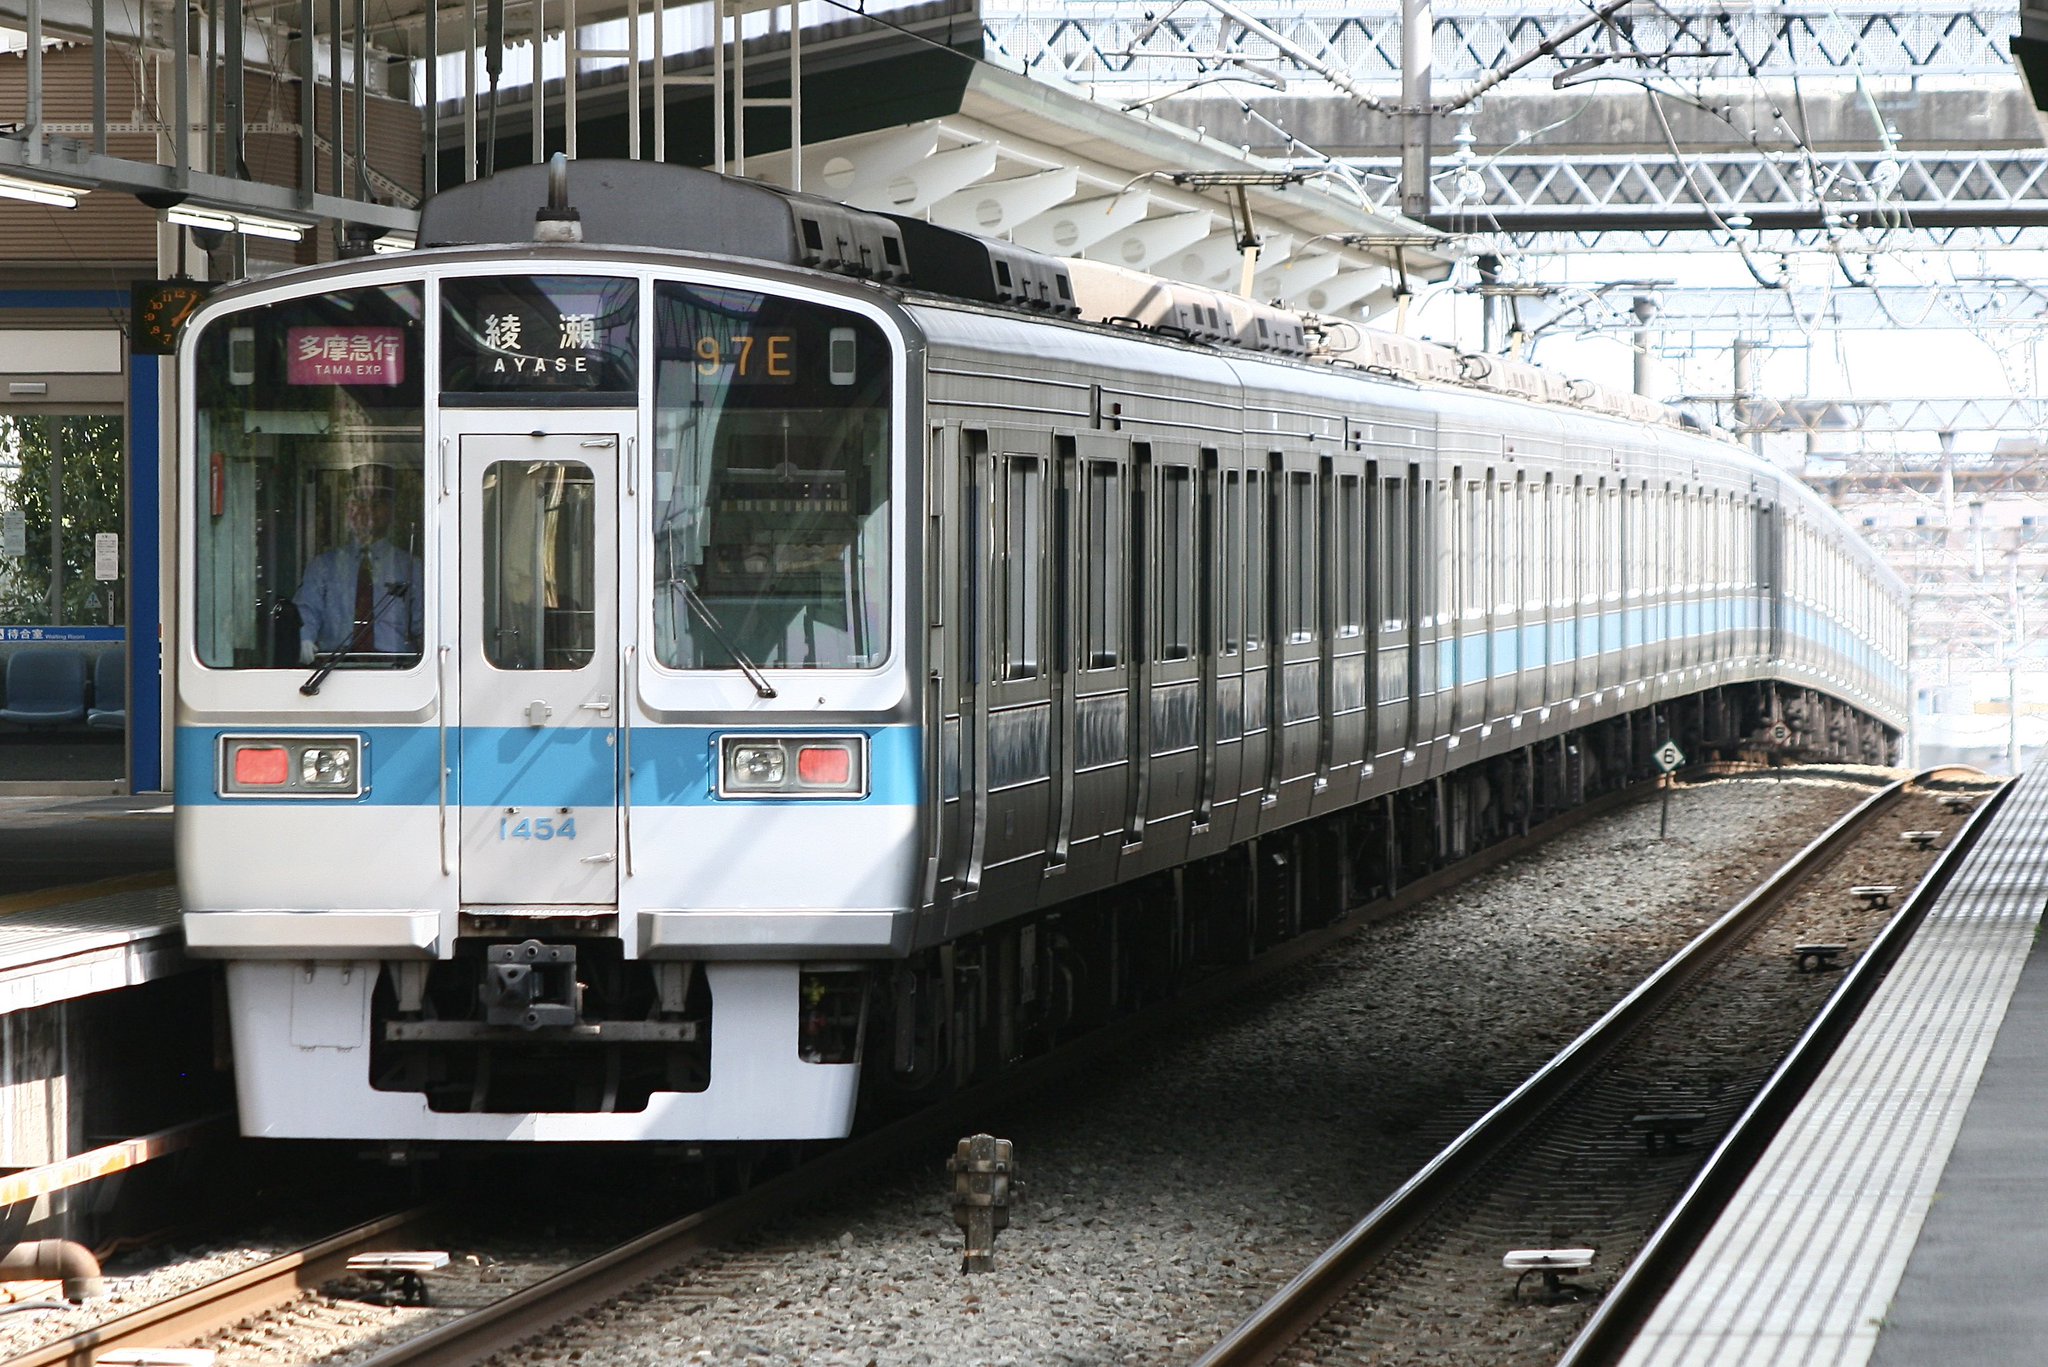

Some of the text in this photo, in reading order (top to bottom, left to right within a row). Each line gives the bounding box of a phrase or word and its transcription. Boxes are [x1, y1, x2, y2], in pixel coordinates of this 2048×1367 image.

[162, 293, 172, 303] 11
[175, 290, 186, 299] 12
[152, 301, 164, 310] 10
[147, 312, 156, 321] 9
[152, 325, 161, 334] 8
[485, 313, 596, 350] 綾瀬
[163, 333, 173, 343] 7
[298, 334, 400, 362] 多摩急行
[697, 336, 791, 376] 97E
[314, 364, 352, 376] TAMA
[494, 357, 587, 372] AYASE
[7, 628, 44, 640] 待合室
[1663, 748, 1675, 764] 6
[499, 817, 577, 841] 1454
